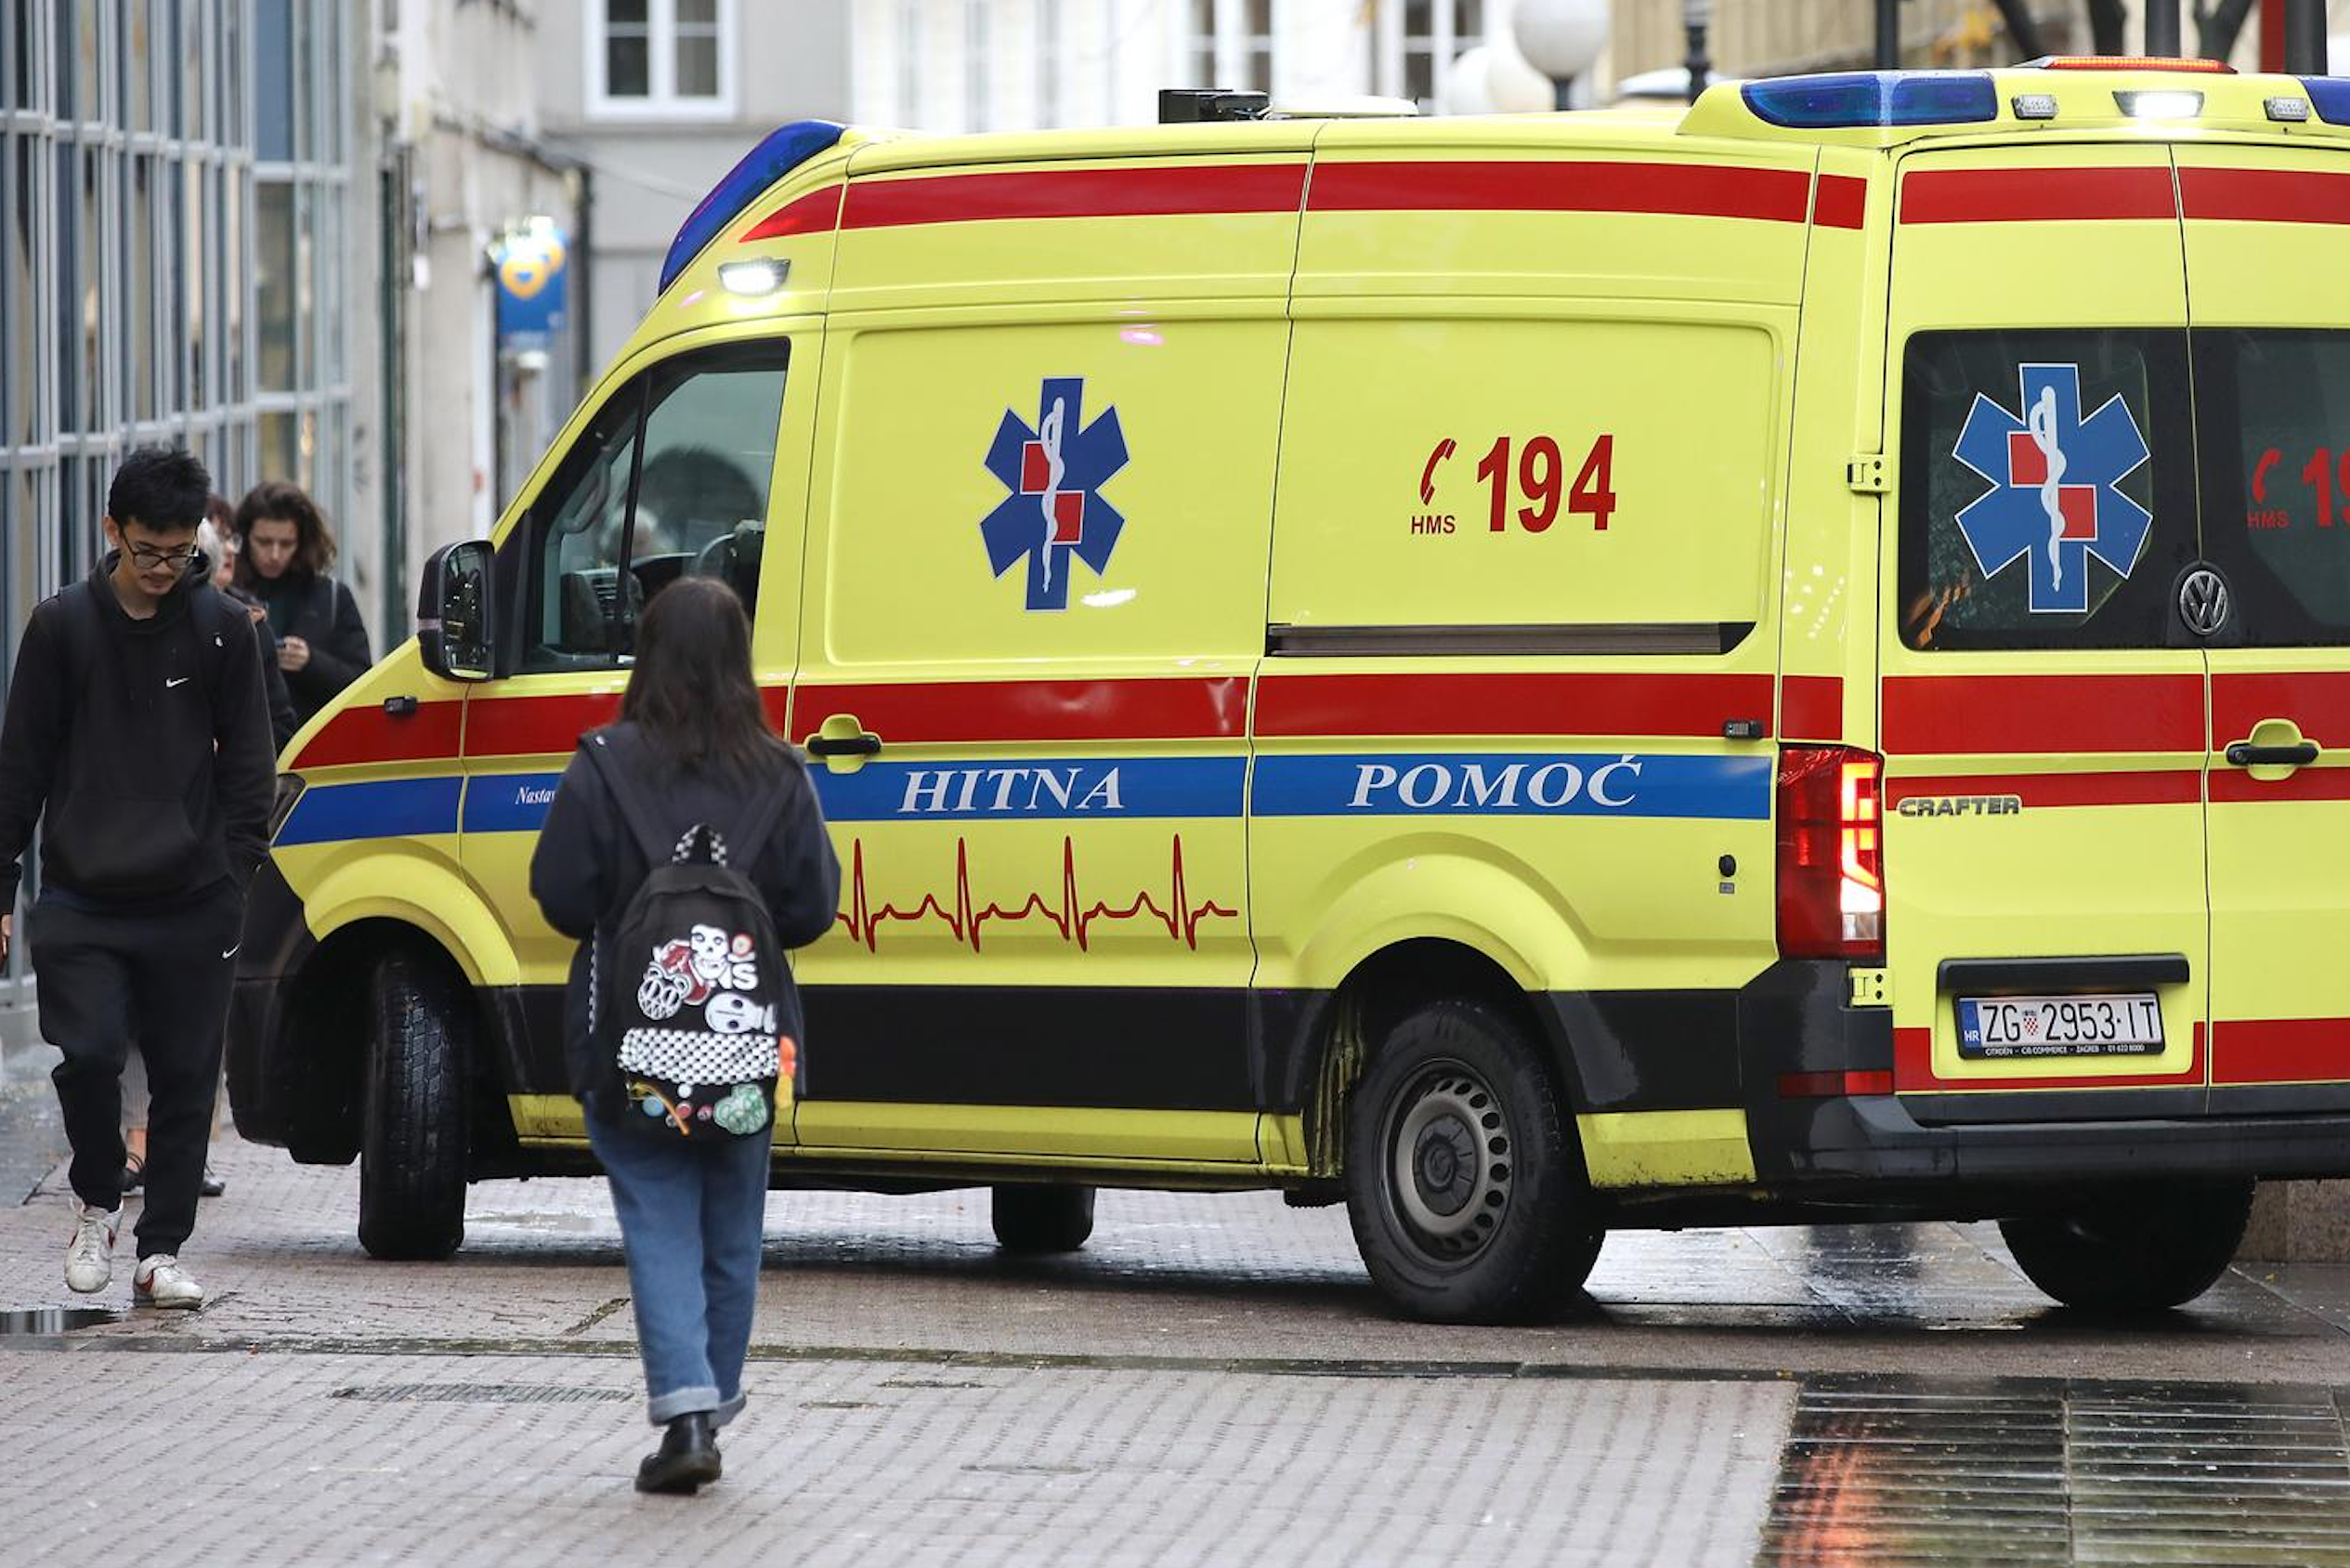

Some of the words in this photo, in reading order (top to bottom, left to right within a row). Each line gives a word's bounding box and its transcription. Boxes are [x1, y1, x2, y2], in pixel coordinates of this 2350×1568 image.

[1477, 435, 1616, 533] 194
[1411, 515, 1456, 534] HMS
[2246, 510, 2291, 530] HMS
[897, 766, 1125, 813] HITNA
[1346, 754, 1642, 807] POMOĆ
[1899, 797, 2019, 817] CRAFTER
[1982, 1004, 2021, 1042] ZG
[1964, 1029, 1980, 1042] HR
